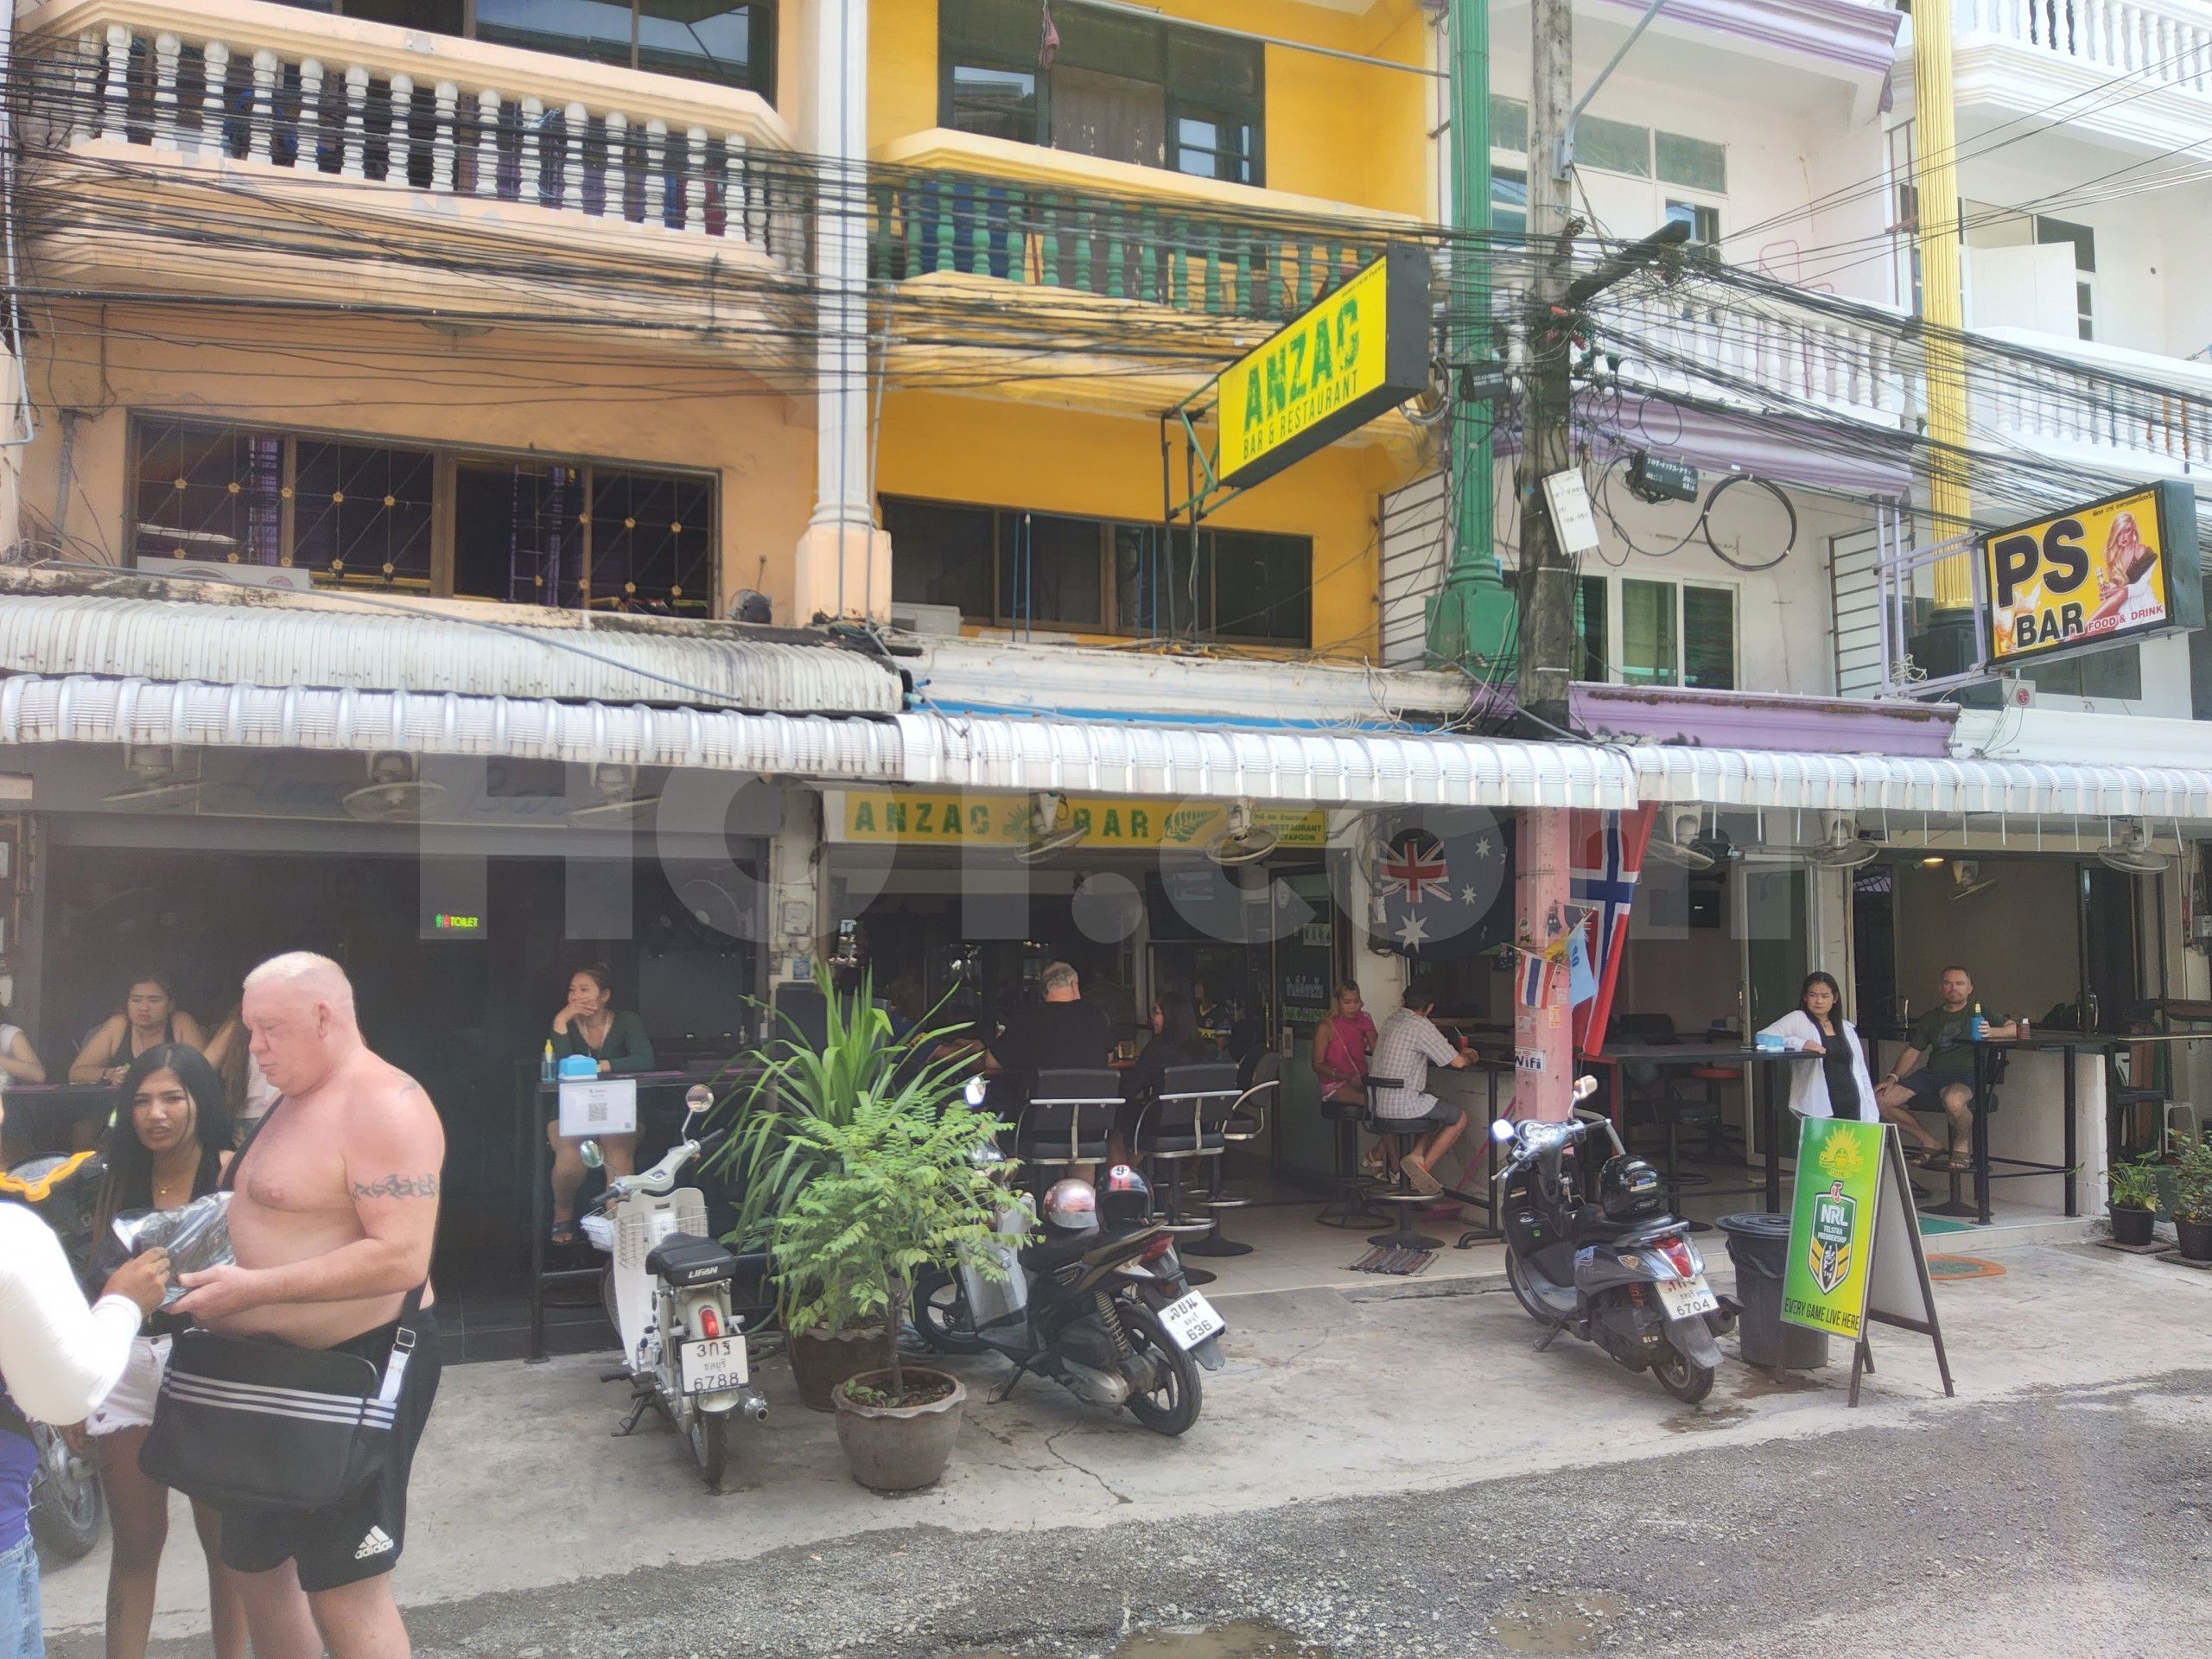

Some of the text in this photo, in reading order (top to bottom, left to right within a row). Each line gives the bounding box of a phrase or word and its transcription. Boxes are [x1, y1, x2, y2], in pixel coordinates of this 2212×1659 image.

[1243, 296, 1360, 433] ANZAC
[1243, 429, 1263, 460] BAR
[1280, 369, 1358, 438] RESTAURANT
[1993, 518, 2089, 609] PS
[2015, 601, 2164, 649] BAR FOOD & DRINK
[854, 801, 1149, 838] ANZAC BAR
[450, 916, 479, 927] TOILET
[1821, 1204, 1849, 1226] NRL
[1817, 1232, 1847, 1243] PREMIERSHIP
[1823, 1225, 1843, 1236] TELSTRA
[688, 1265, 719, 1279] LIFAN
[1676, 1299, 1711, 1316] 6704
[1784, 1297, 1860, 1331] EVERY GAME LIVE HERE
[1186, 1319, 1213, 1341] 636
[694, 1371, 740, 1391] 6788
[354, 1539, 394, 1560] adidas
